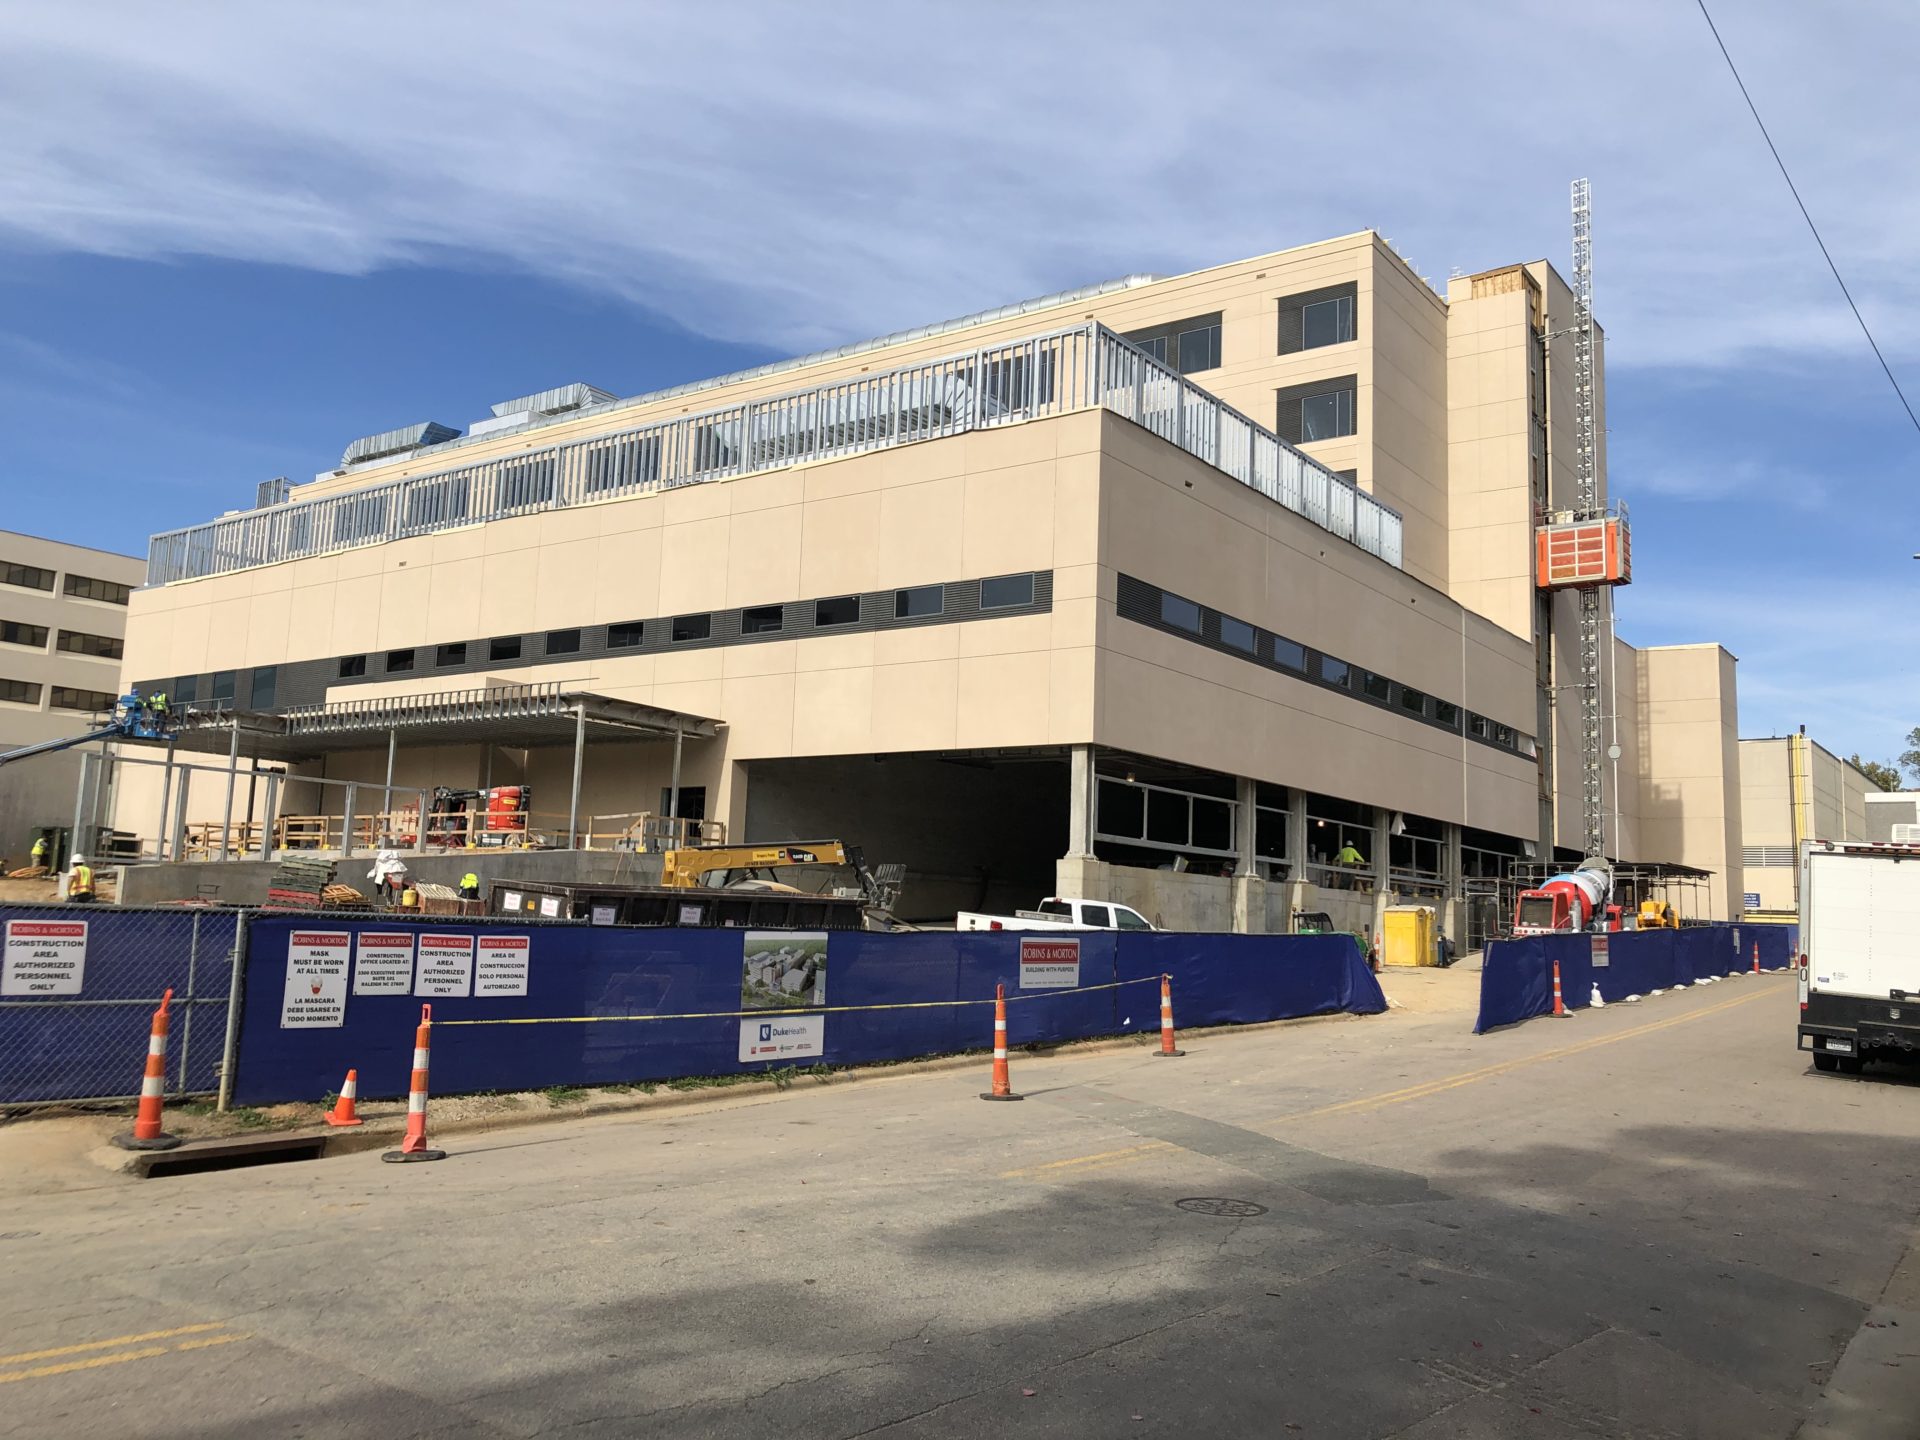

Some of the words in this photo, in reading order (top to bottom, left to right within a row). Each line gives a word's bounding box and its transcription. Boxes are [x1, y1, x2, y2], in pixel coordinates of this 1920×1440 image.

[1024, 948, 1045, 958] ROBINS
[1047, 949, 1050, 958] &
[1052, 948, 1076, 959] MORTON
[772, 1027, 806, 1036] DukeHealth
